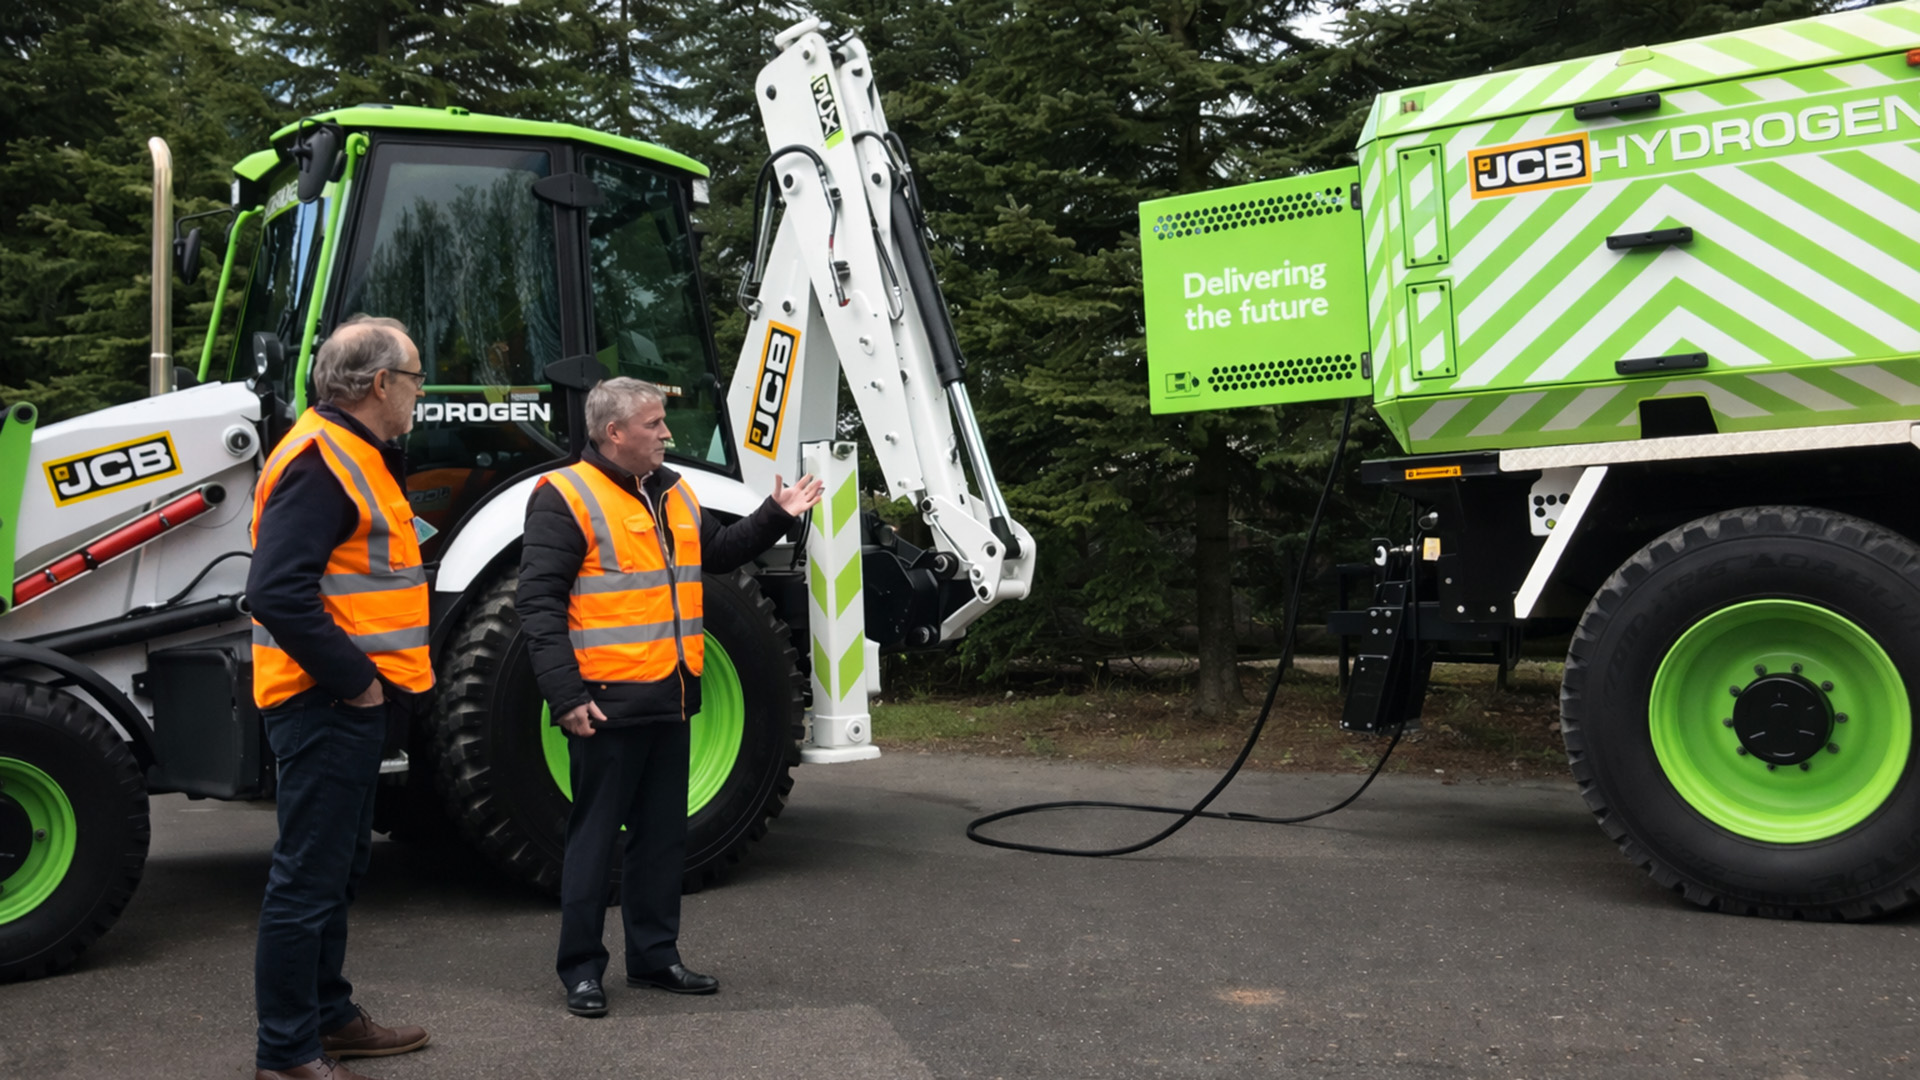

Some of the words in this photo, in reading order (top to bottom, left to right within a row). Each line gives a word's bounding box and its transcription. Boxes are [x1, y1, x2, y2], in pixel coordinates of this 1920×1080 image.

[1478, 144, 1583, 188] JCB
[1183, 259, 1328, 299] Delivering
[1185, 303, 1232, 331] the
[1239, 296, 1329, 325] future
[756, 332, 792, 447] JCB
[58, 441, 171, 496] JCB
